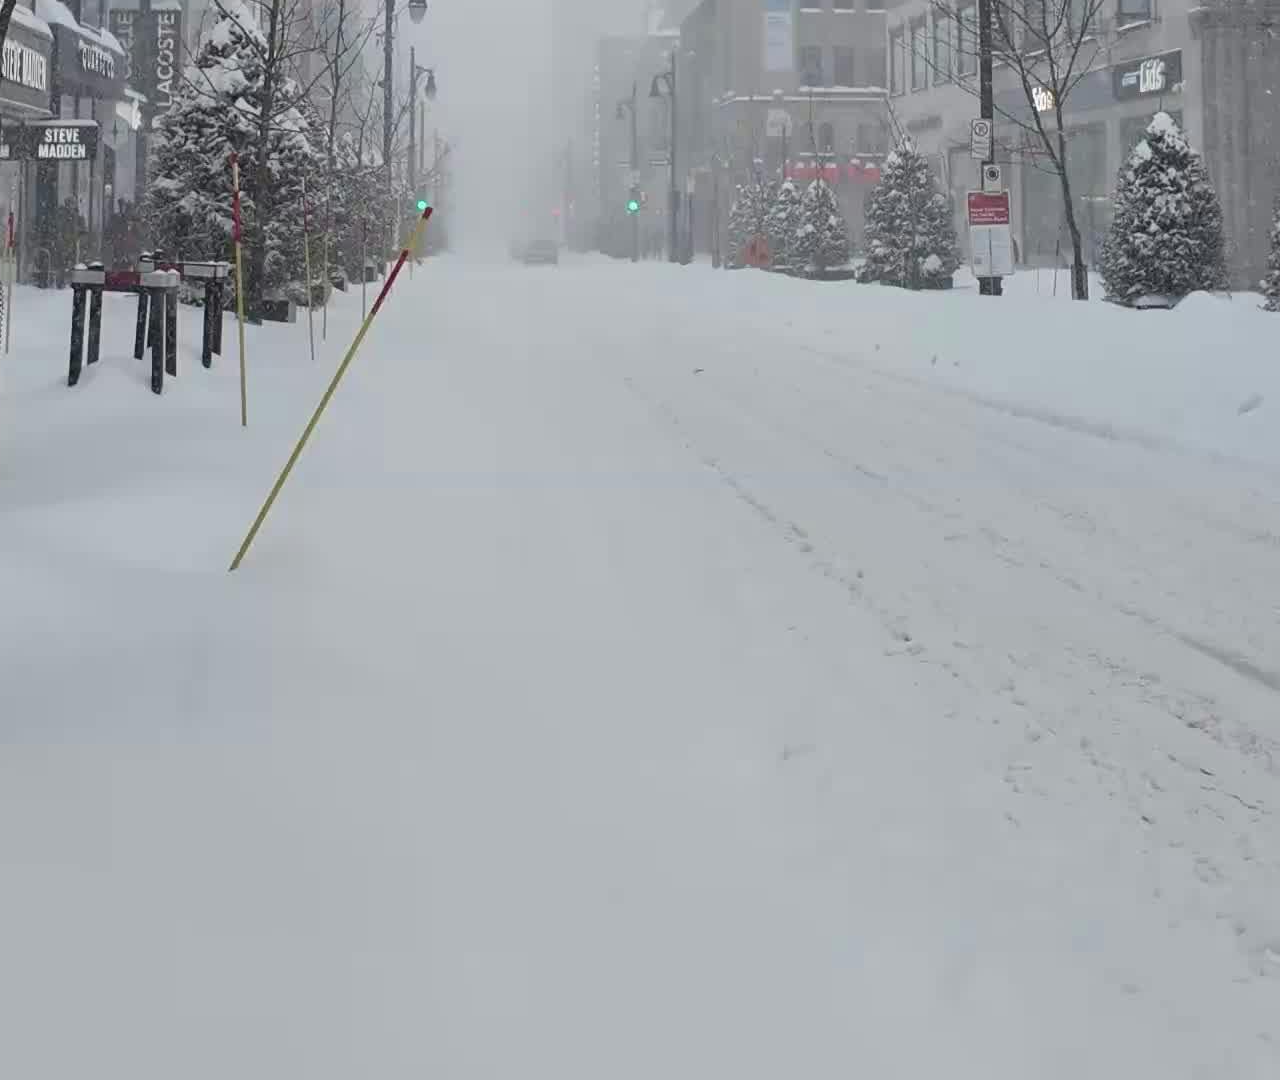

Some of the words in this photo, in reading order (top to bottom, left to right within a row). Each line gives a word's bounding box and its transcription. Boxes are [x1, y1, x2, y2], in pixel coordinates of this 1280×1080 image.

[156, 13, 176, 107] LACOSTE
[45, 128, 80, 143] STEVE
[38, 143, 86, 159] MADDEN
